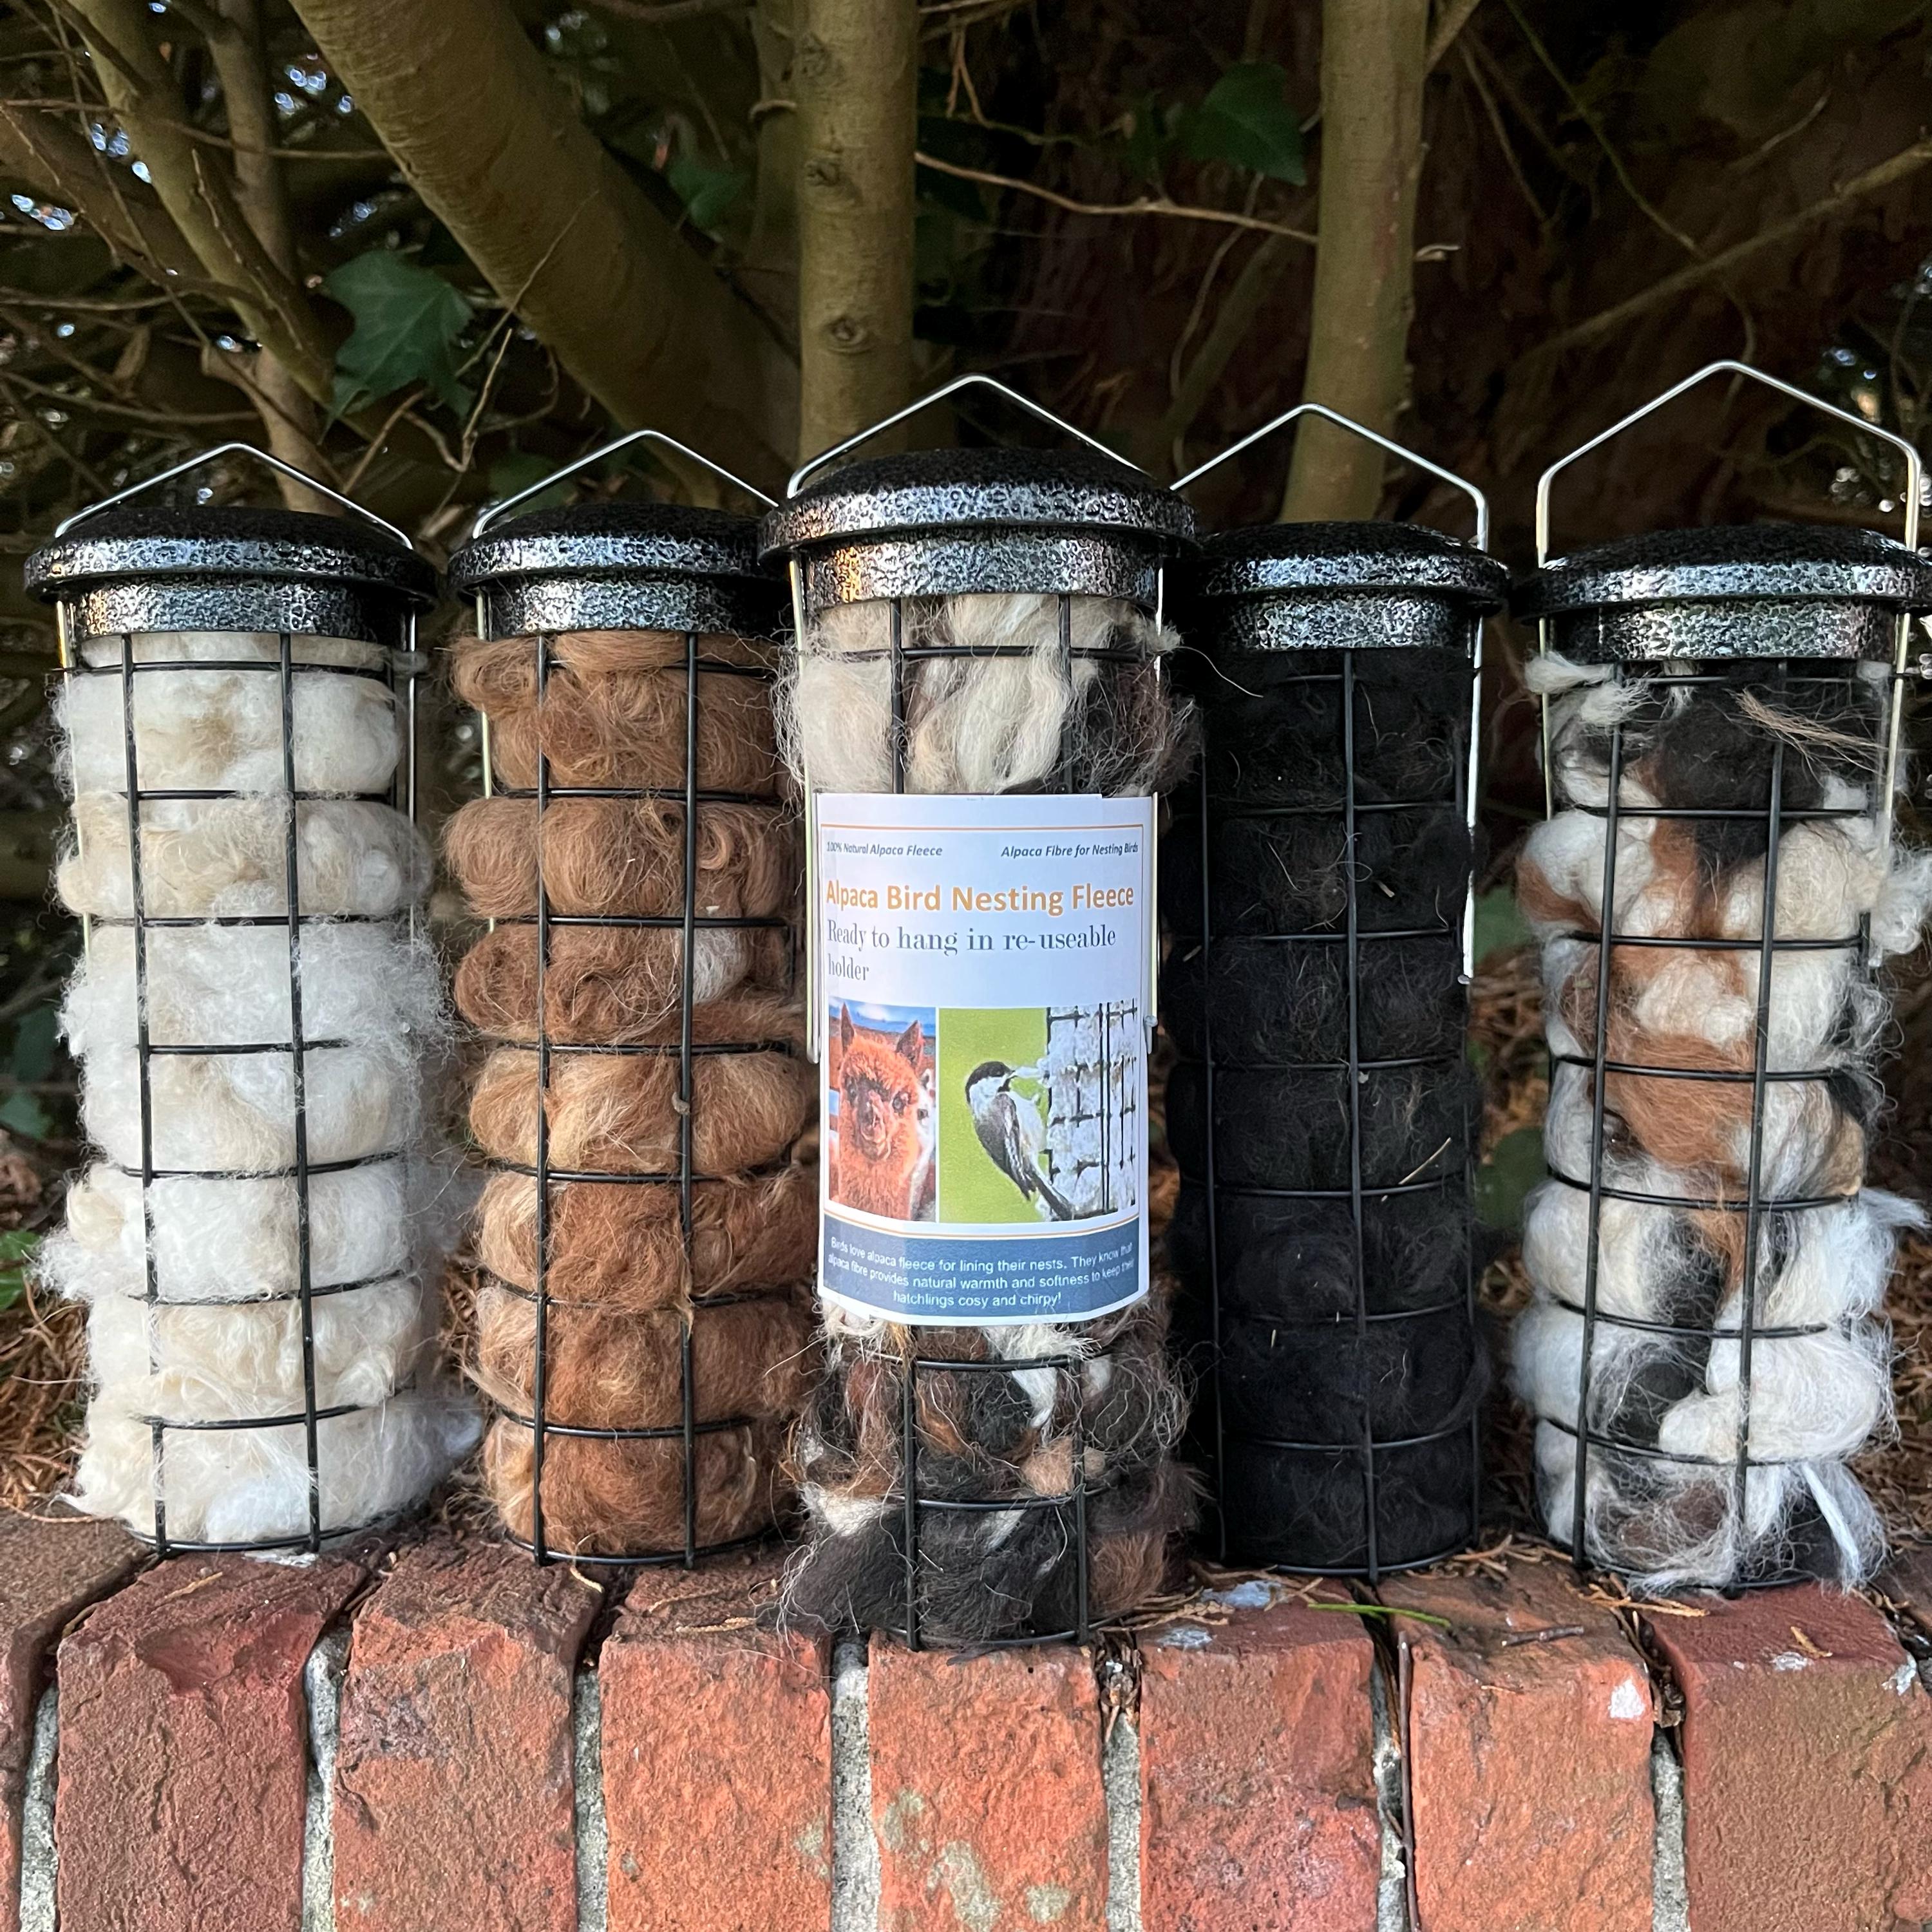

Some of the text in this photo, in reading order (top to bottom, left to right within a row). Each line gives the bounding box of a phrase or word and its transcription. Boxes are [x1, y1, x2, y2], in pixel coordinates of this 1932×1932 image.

[827, 842, 942, 857] 100% Natural Alpaca Fleece
[1001, 842, 1138, 859] Alpaca Fibre for Nesting Birds
[826, 880, 1134, 916] Alpaca Bird Nesting Fleece
[828, 920, 1115, 956] Ready to hang in re-useable
[828, 954, 869, 981] holder
[831, 1236, 848, 1252] Birds
[849, 1244, 866, 1258] love
[867, 1249, 896, 1269] alpaca
[899, 1256, 935, 1271] fleece
[939, 1260, 956, 1271] for
[960, 1260, 993, 1273] lining
[998, 1260, 1025, 1271] their
[1030, 1259, 1067, 1271] nests.
[1071, 1255, 1097, 1269] They
[1099, 1248, 1119, 1262] know
[828, 1255, 849, 1271] alpaca
[851, 1261, 867, 1276] fibre
[870, 1270, 909, 1287] provides
[913, 1276, 956, 1289] natural
[960, 1278, 1007, 1289] warmth
[1012, 1276, 1035, 1288] and
[1039, 1273, 1089, 1287] softness
[1092, 1271, 1100, 1282] to
[1102, 1265, 1121, 1280] keep
[893, 1291, 1061, 1308] hatchlings cosy and chirpy!
